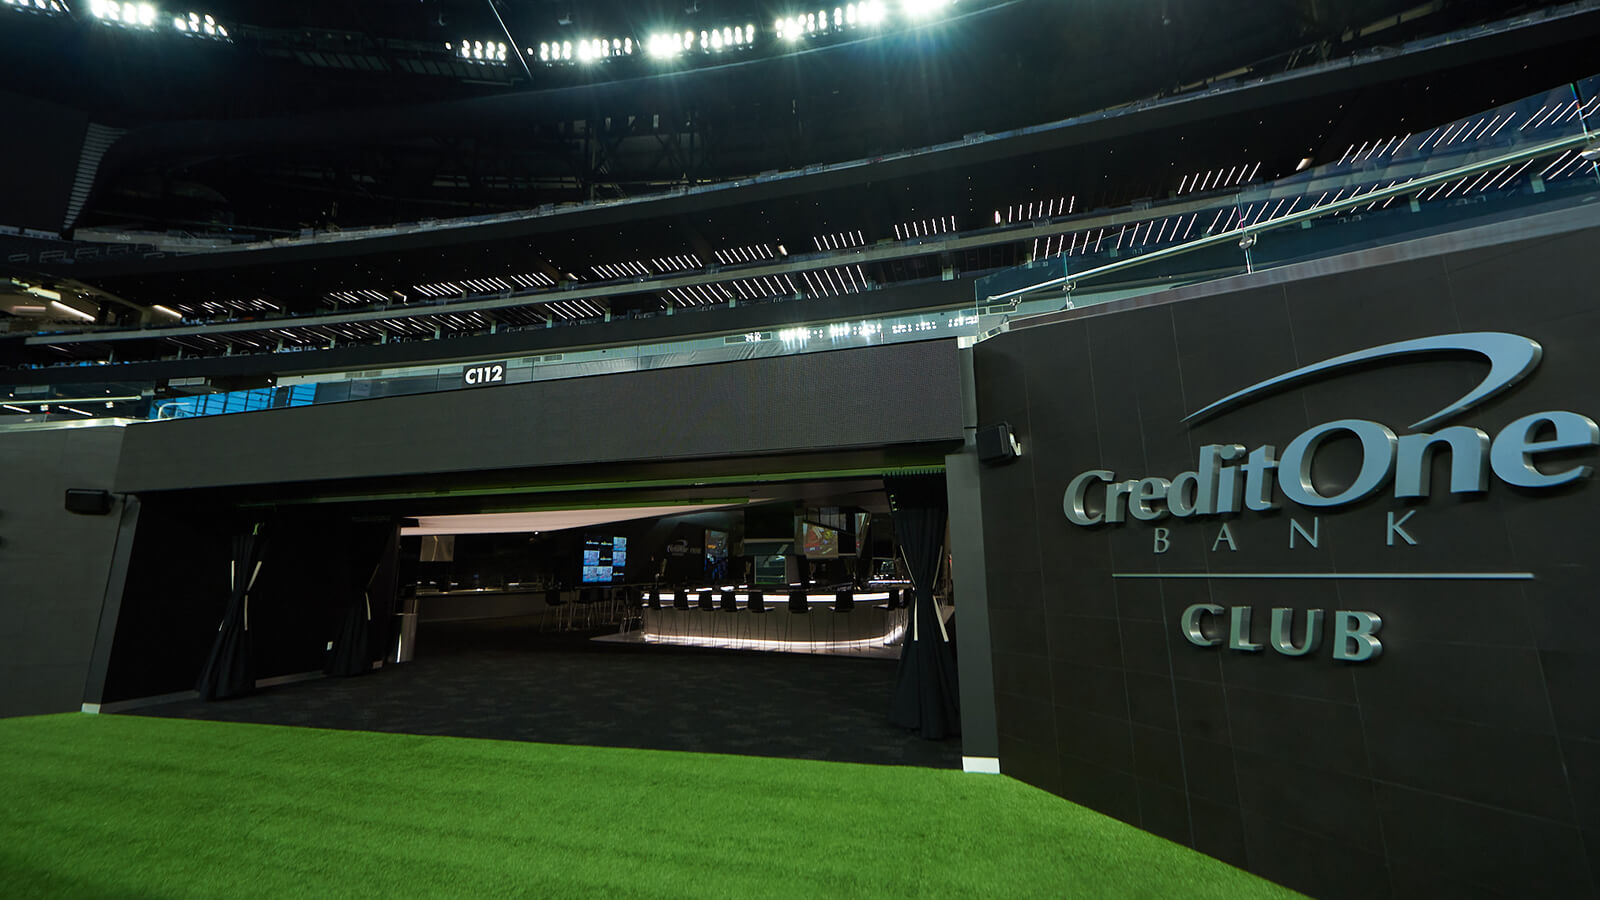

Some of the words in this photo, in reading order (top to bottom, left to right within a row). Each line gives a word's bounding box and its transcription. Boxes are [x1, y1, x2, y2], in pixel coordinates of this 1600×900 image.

[465, 365, 503, 384] C112
[1153, 510, 1418, 553] BANK
[1181, 604, 1383, 661] CLUB
